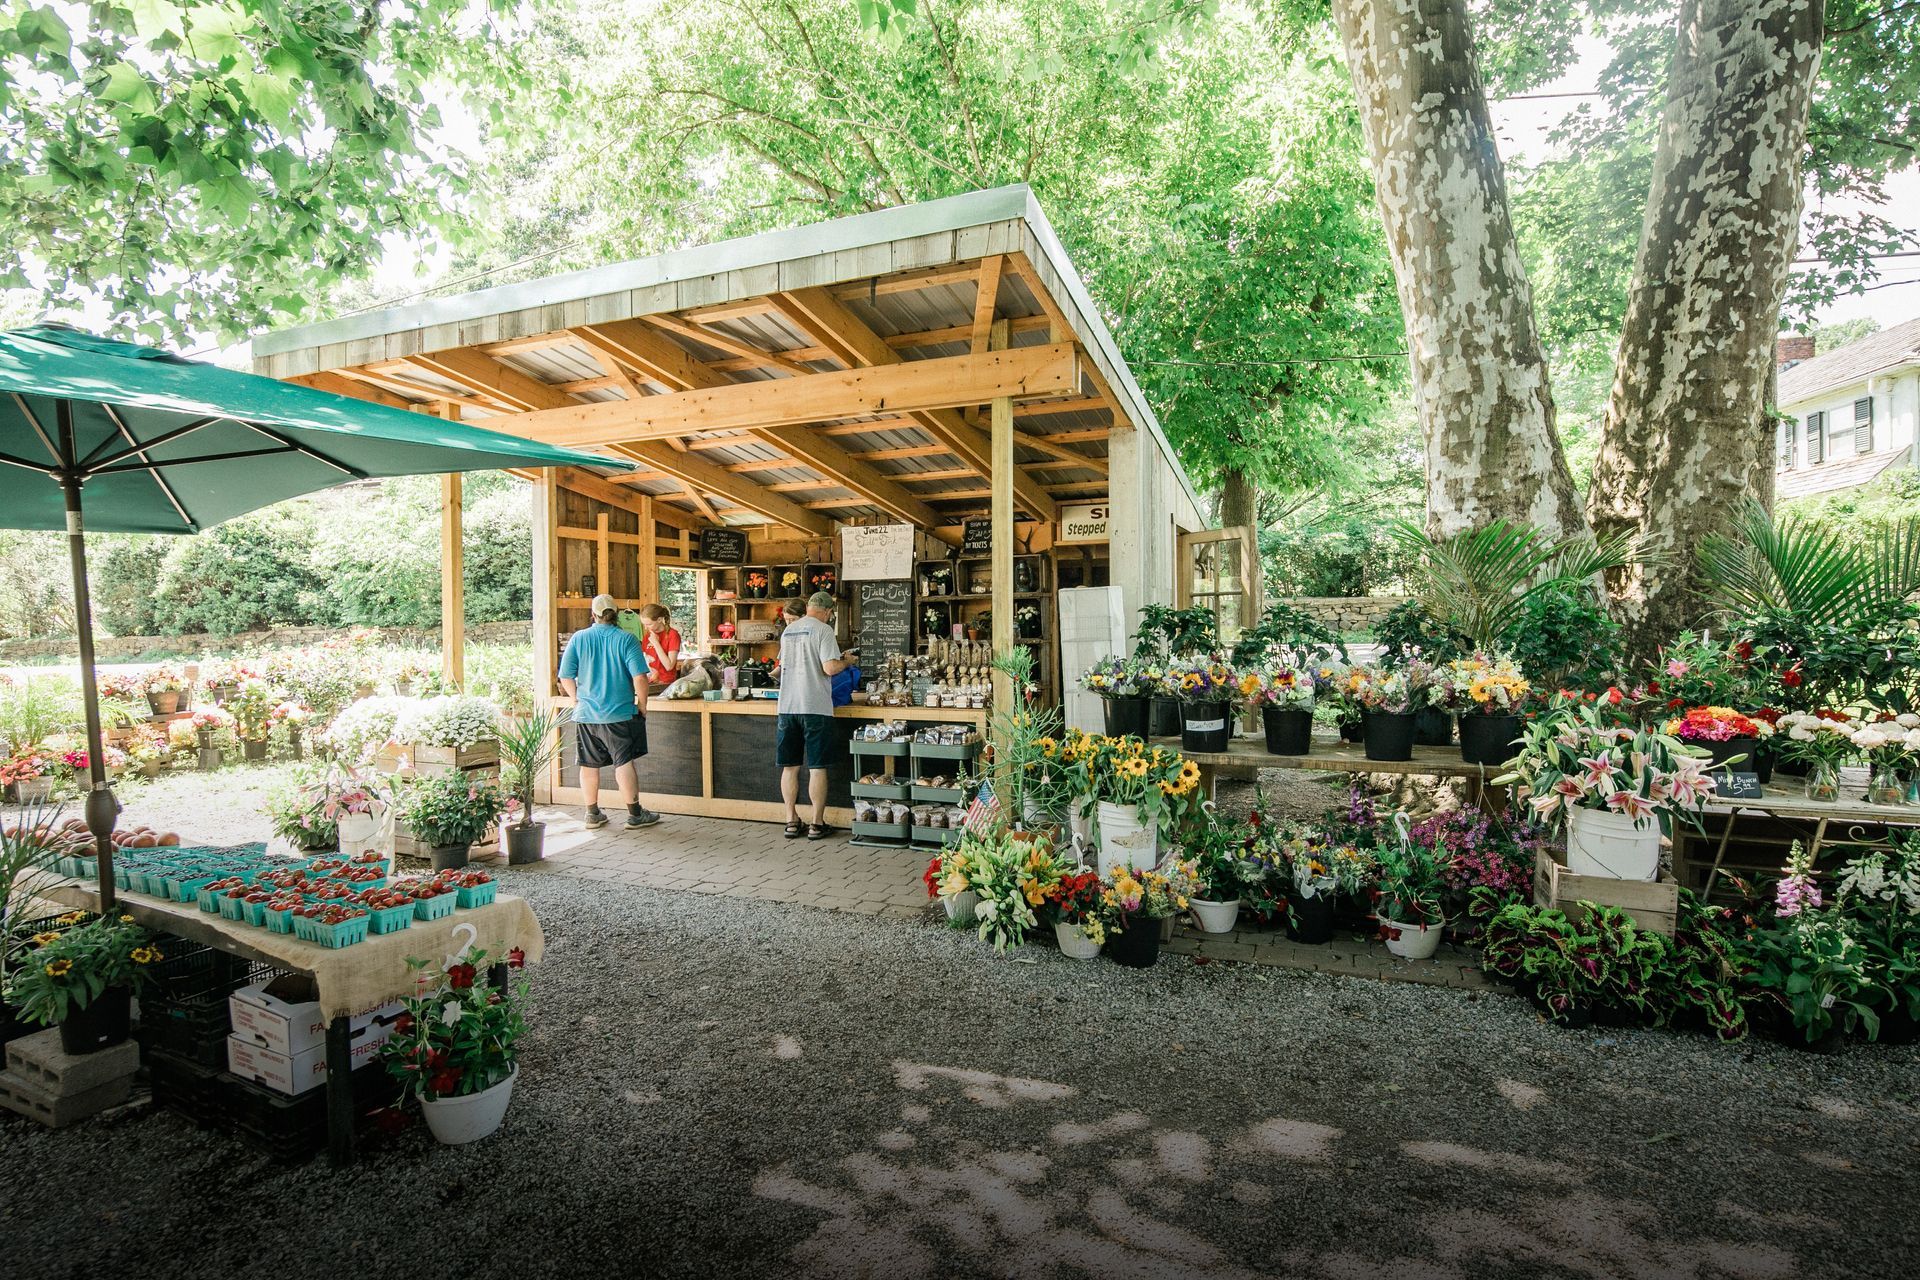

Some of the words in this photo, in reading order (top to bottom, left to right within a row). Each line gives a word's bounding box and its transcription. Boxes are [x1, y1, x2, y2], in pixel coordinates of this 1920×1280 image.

[879, 526, 888, 534] 22
[1068, 521, 1106, 536] Stepped
[861, 583, 885, 600] Field
[888, 583, 911, 600] Fork
[1736, 776, 1757, 784] BUNCH
